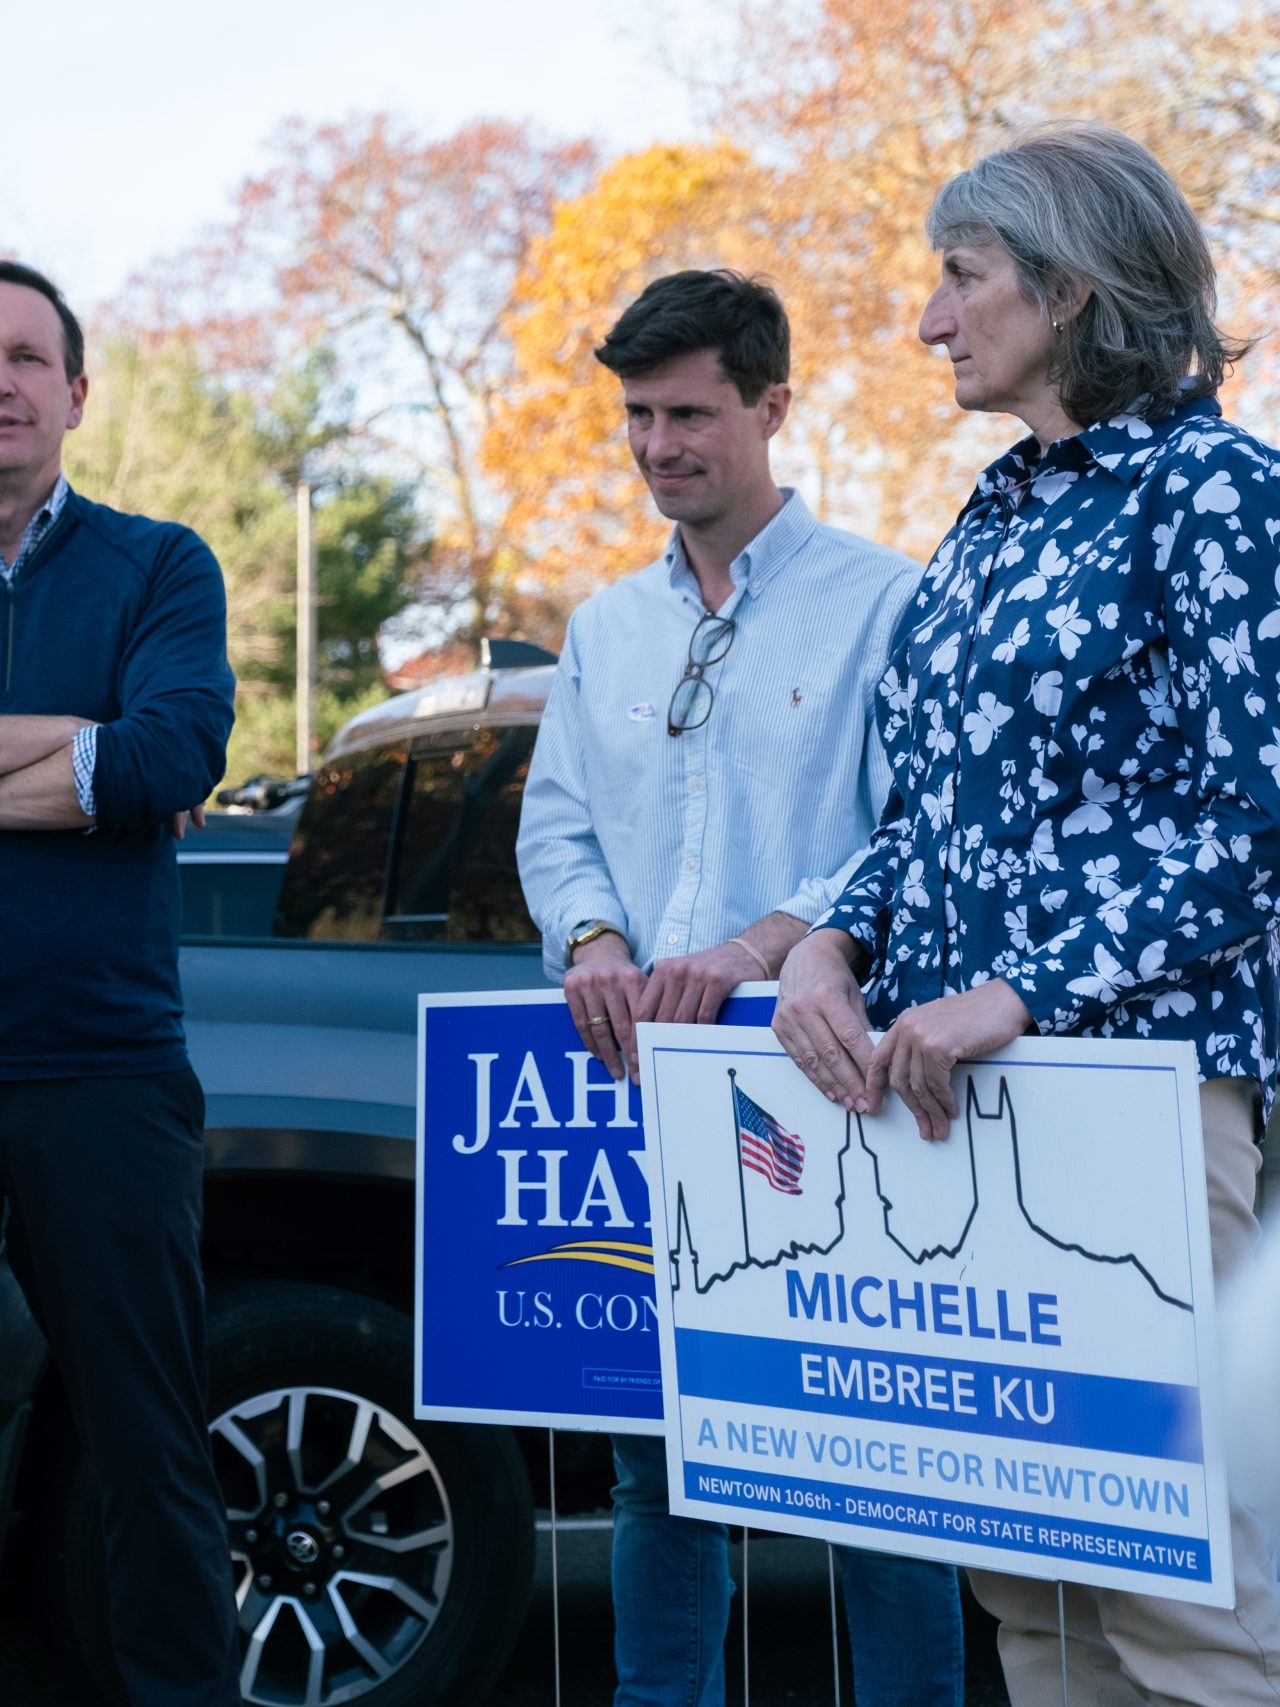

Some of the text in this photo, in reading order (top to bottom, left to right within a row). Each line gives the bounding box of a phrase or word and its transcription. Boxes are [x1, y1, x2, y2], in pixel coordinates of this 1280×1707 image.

[452, 1051, 641, 1154] JAH
[496, 1291, 562, 1328] U.S.
[786, 1269, 1062, 1346] MICHELLE
[801, 1353, 1055, 1424] EMBREE KU
[698, 1418, 1189, 1517] A NEW VOICE FOR NEWTOWN
[698, 1475, 781, 1503] NEWTOWN
[785, 1489, 831, 1511] 106th
[845, 1498, 938, 1527] DEMOCRAT
[943, 1512, 976, 1534] FOR
[981, 1518, 1033, 1543] STATE
[1039, 1527, 1198, 1570] REPRESENTATIVE
